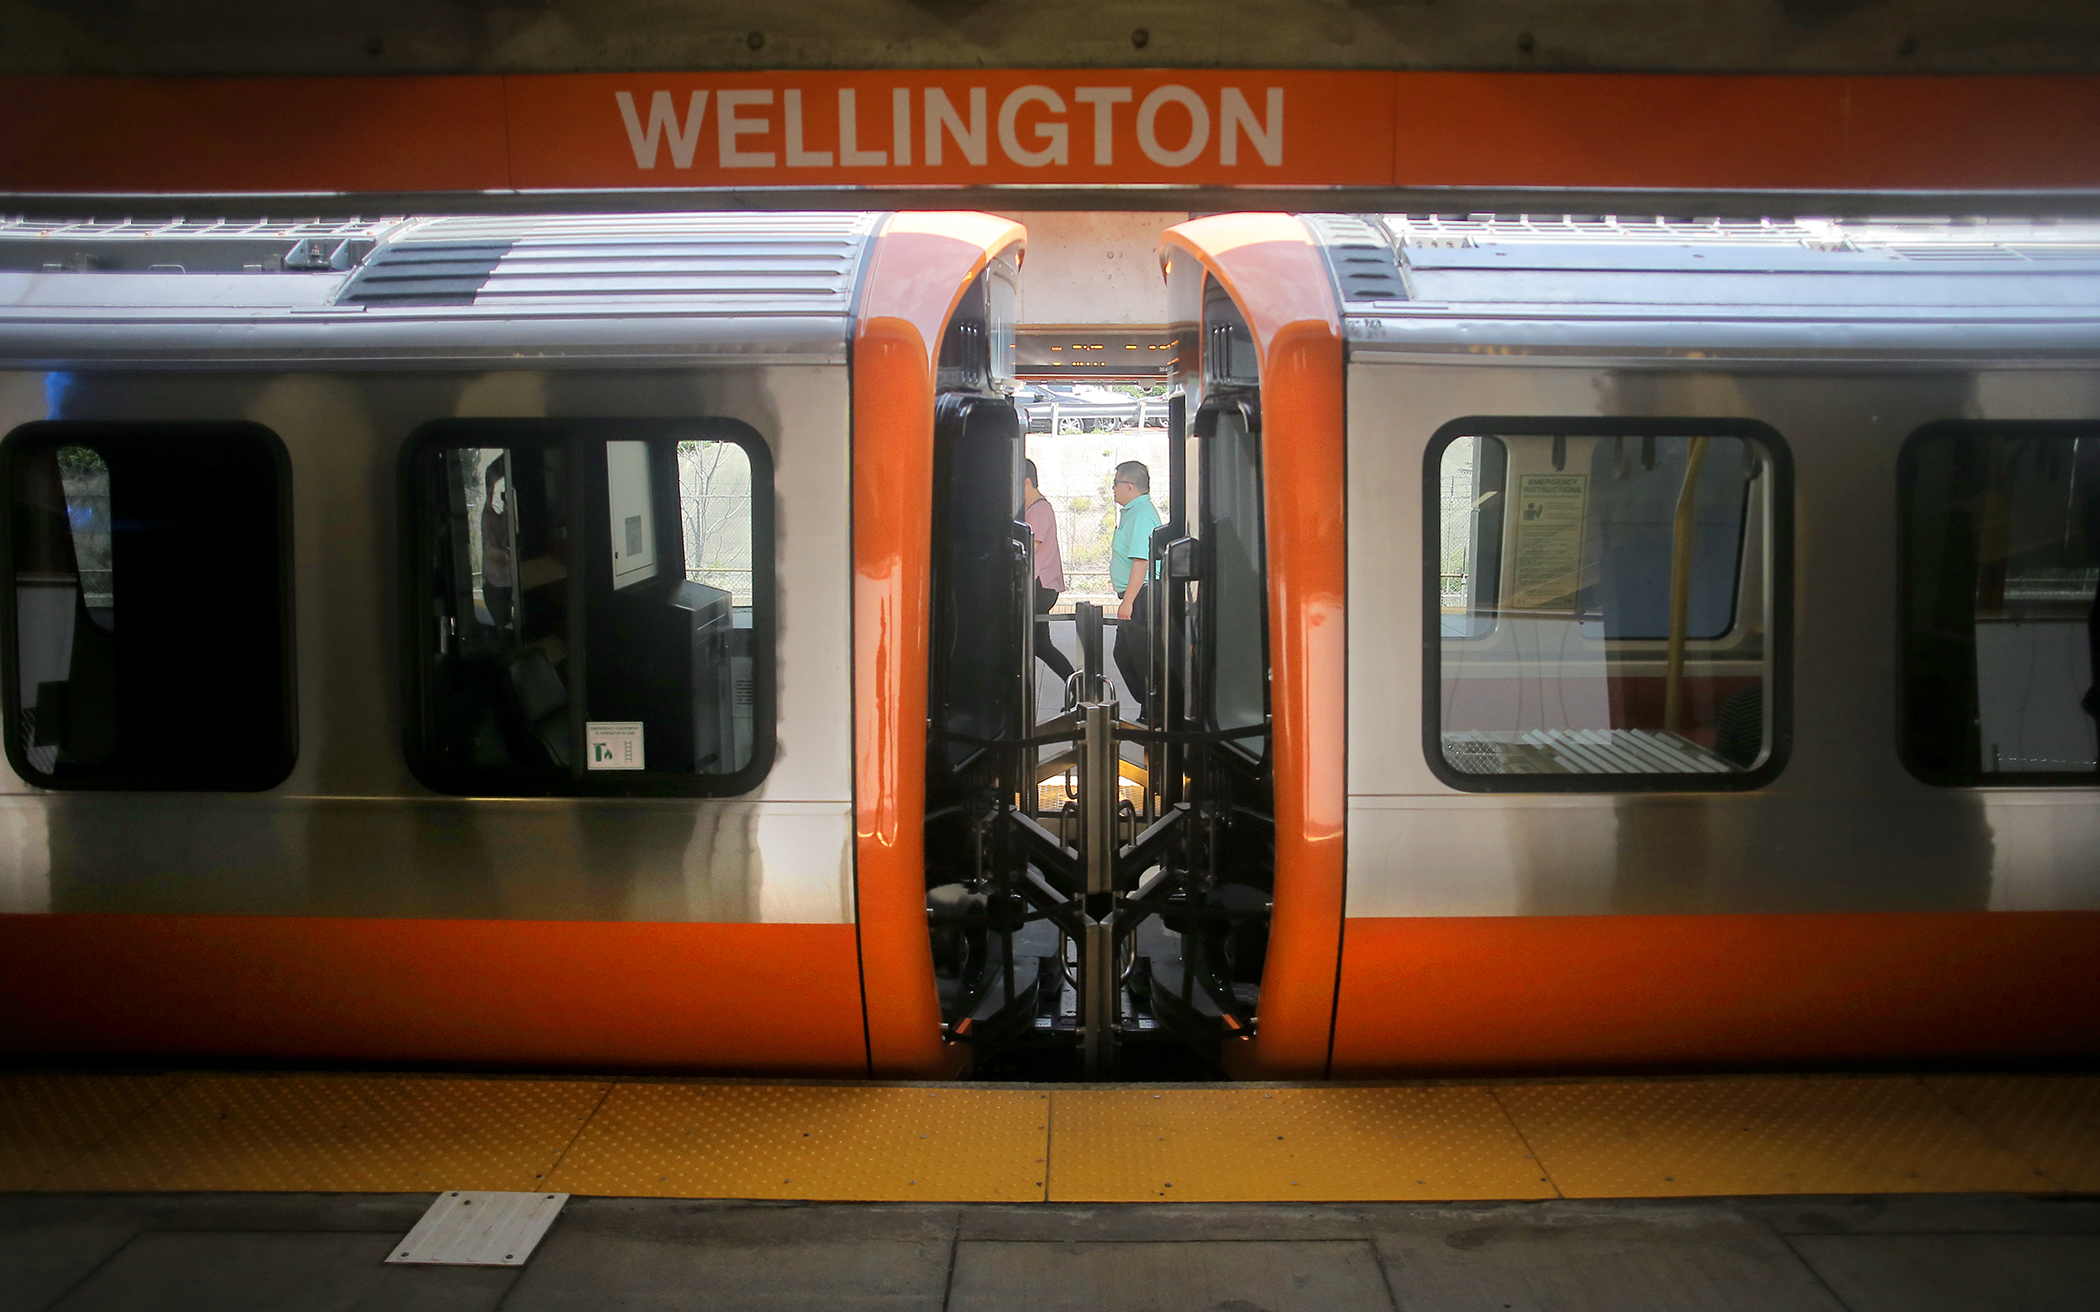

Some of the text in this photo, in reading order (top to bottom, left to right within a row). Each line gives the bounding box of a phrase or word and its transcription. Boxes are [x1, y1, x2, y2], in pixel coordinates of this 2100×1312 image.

[615, 84, 1284, 169] WELLINGTON
[1528, 478, 1578, 486] EMERGENCY
[1523, 486, 1582, 494] INSTRUCTIONS
